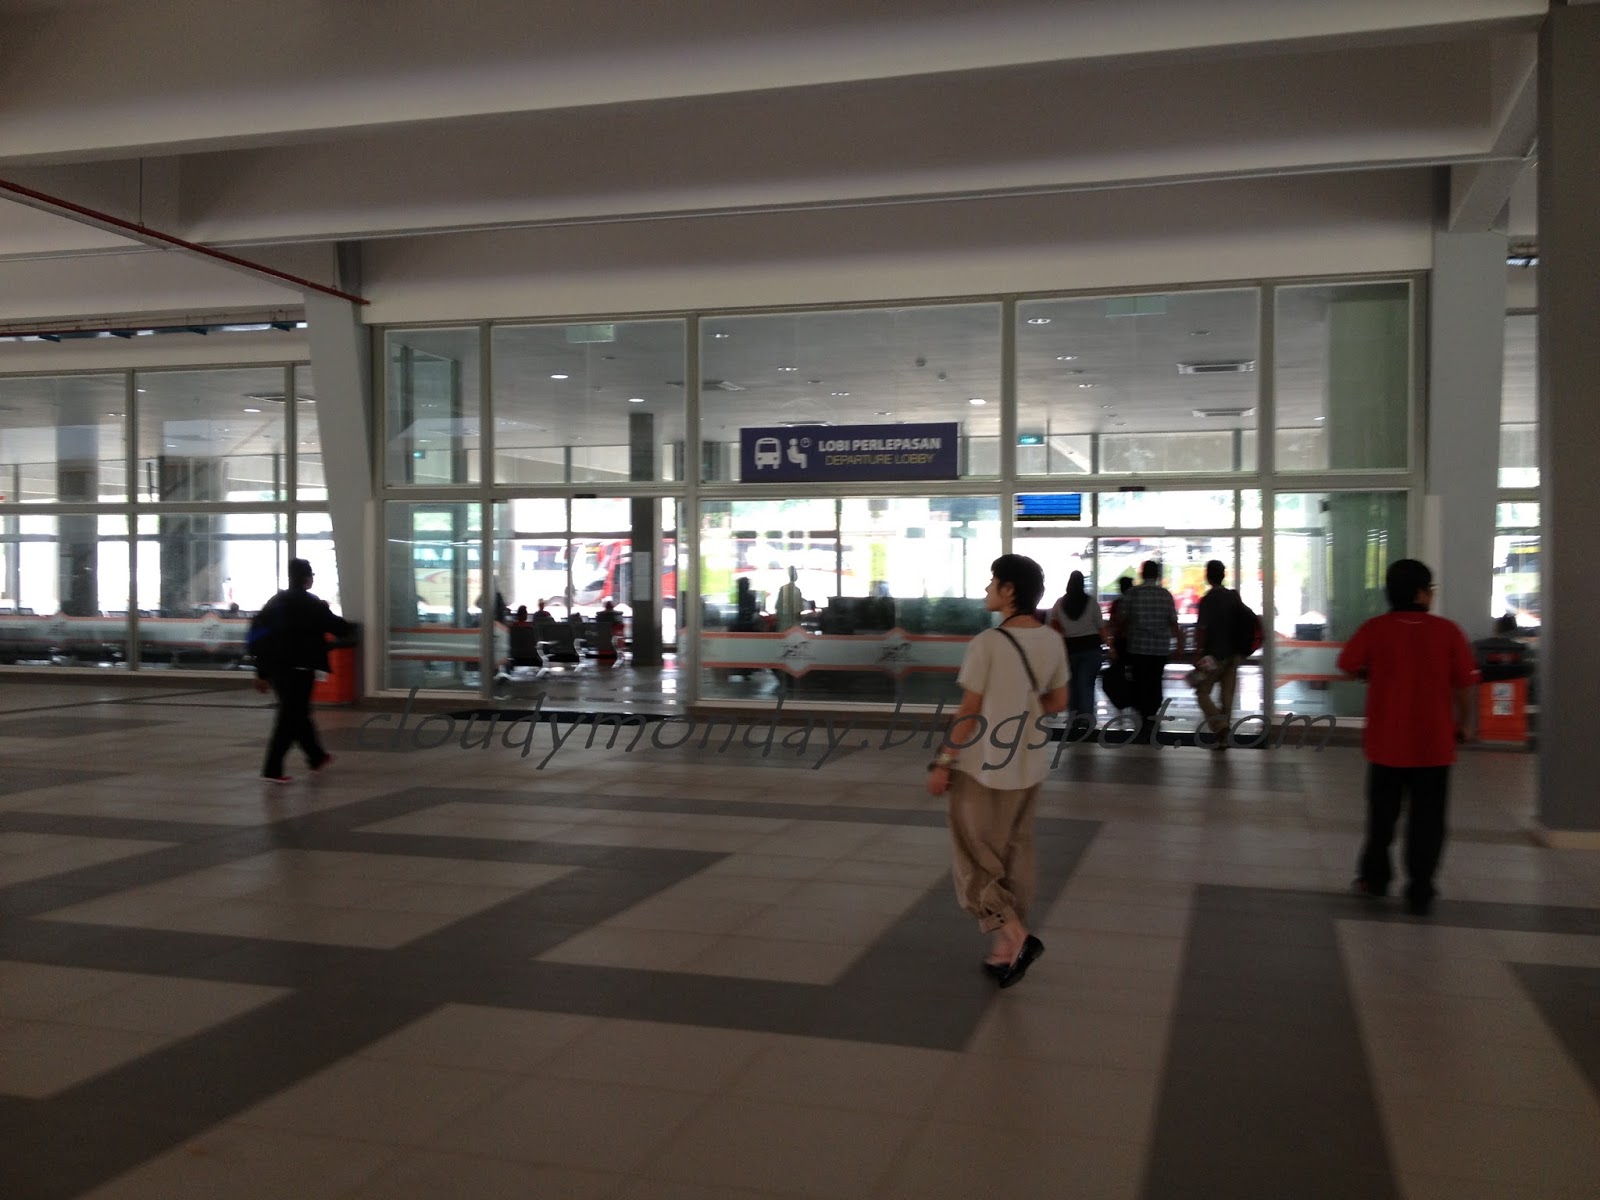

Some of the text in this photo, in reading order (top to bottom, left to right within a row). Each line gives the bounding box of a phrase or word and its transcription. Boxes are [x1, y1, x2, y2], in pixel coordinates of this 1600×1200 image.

[818, 437, 942, 452] LOBI PERLEPASAN
[825, 453, 935, 466] DEPARTURE LOBBY
